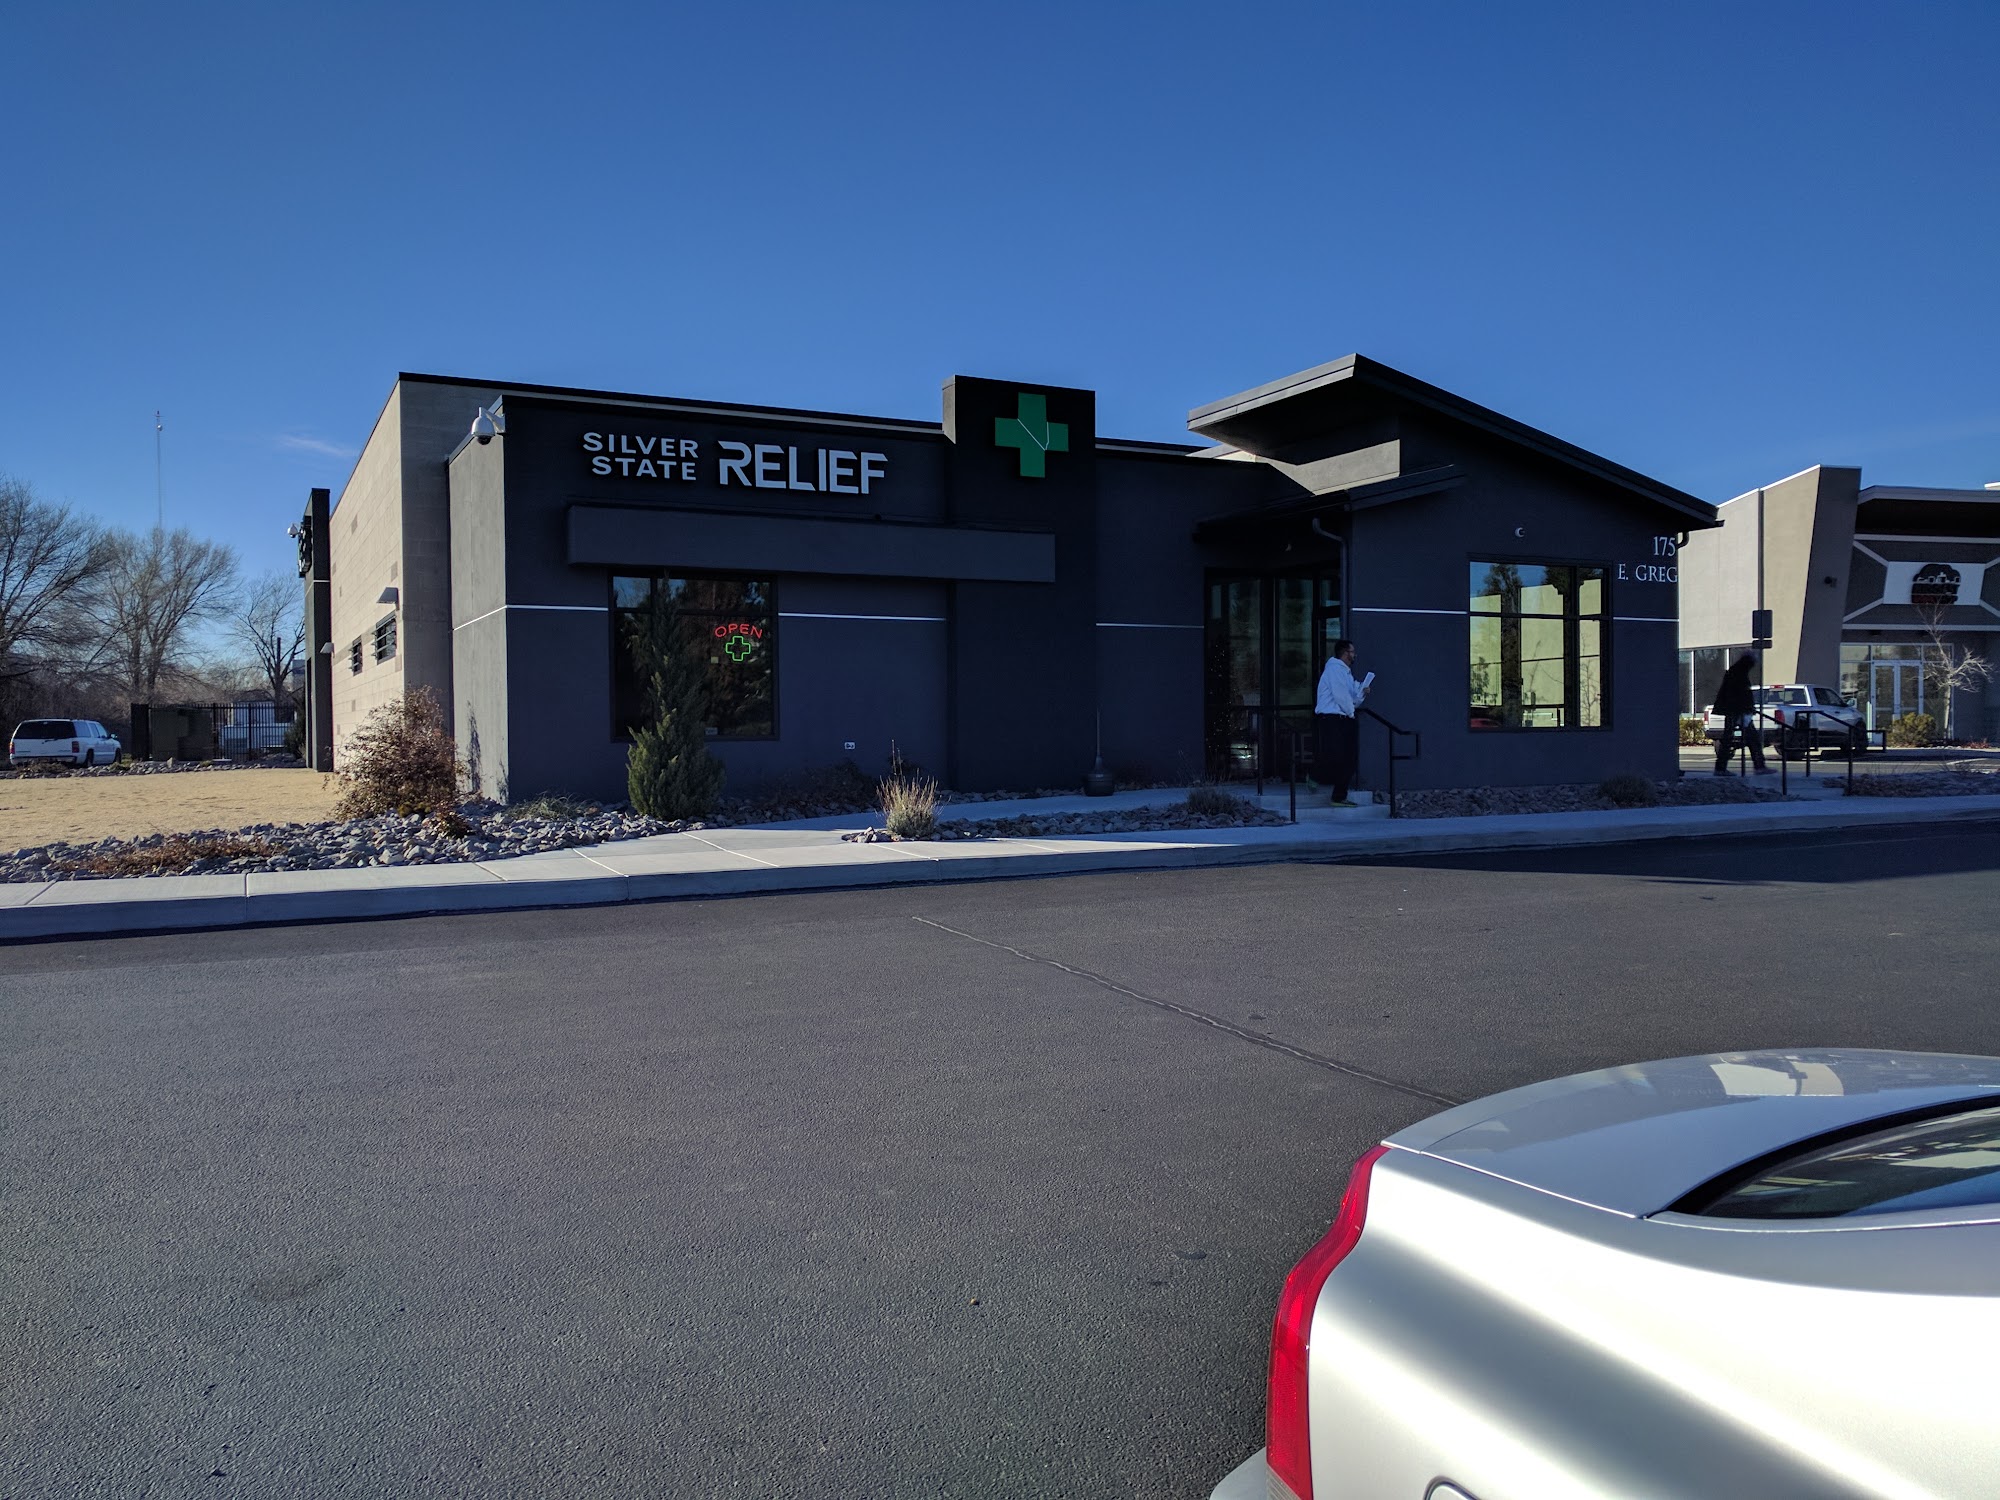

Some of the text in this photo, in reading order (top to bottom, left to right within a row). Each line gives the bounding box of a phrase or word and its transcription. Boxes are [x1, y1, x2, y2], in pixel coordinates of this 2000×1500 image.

[583, 432, 699, 458] SILVER
[591, 456, 697, 481] STATE
[718, 440, 888, 494] RELIEF
[1653, 536, 1676, 557] 175
[1618, 563, 1678, 583] E. GREG
[714, 623, 763, 639] OPEN
